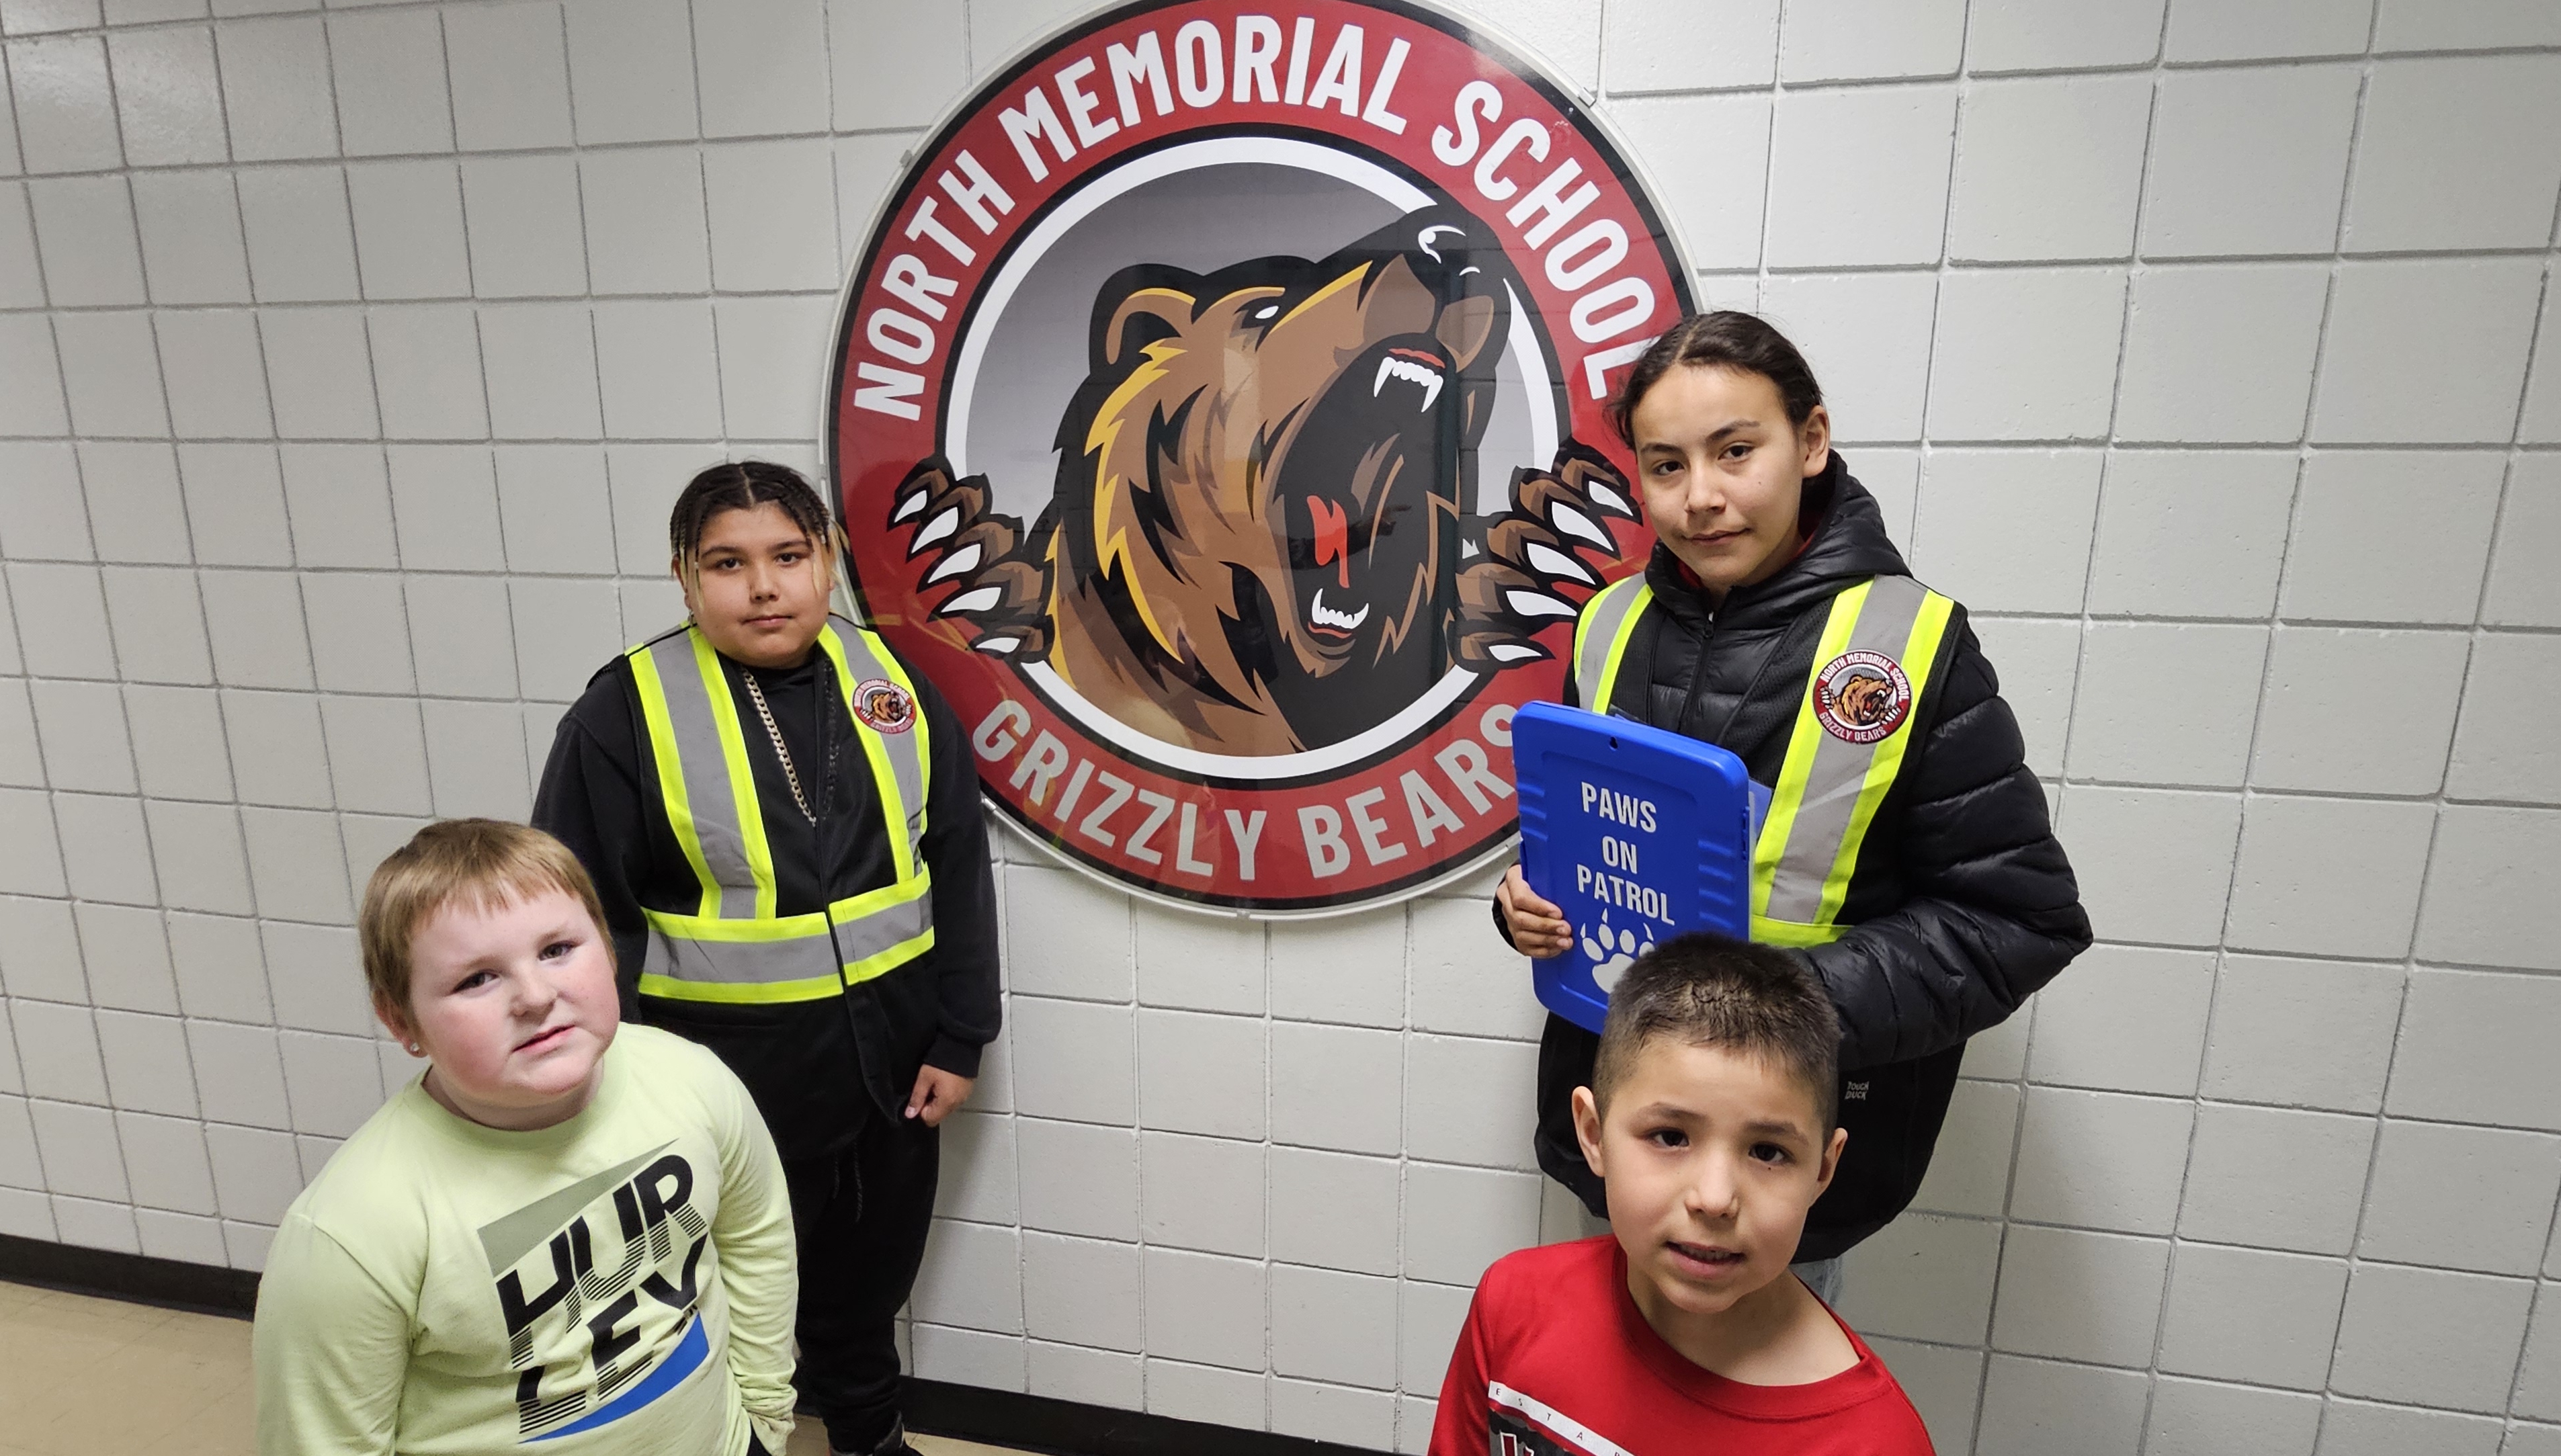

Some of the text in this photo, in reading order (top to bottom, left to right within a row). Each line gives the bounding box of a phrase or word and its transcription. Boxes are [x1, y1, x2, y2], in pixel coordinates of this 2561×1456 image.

[853, 15, 1662, 421] NORTH MEMORIAL SCHOOL
[1820, 652, 1910, 702] NORTH MEMORIAL SCHOOL
[1819, 712, 1853, 740] GRIZZLY
[972, 699, 1267, 881] GRIZZLY
[1581, 781, 1657, 834] PAWS
[1602, 836, 1638, 874] ON
[1577, 864, 1676, 926] PATROL
[1845, 1090, 1867, 1101] DUCK
[496, 1154, 708, 1369] HUR
